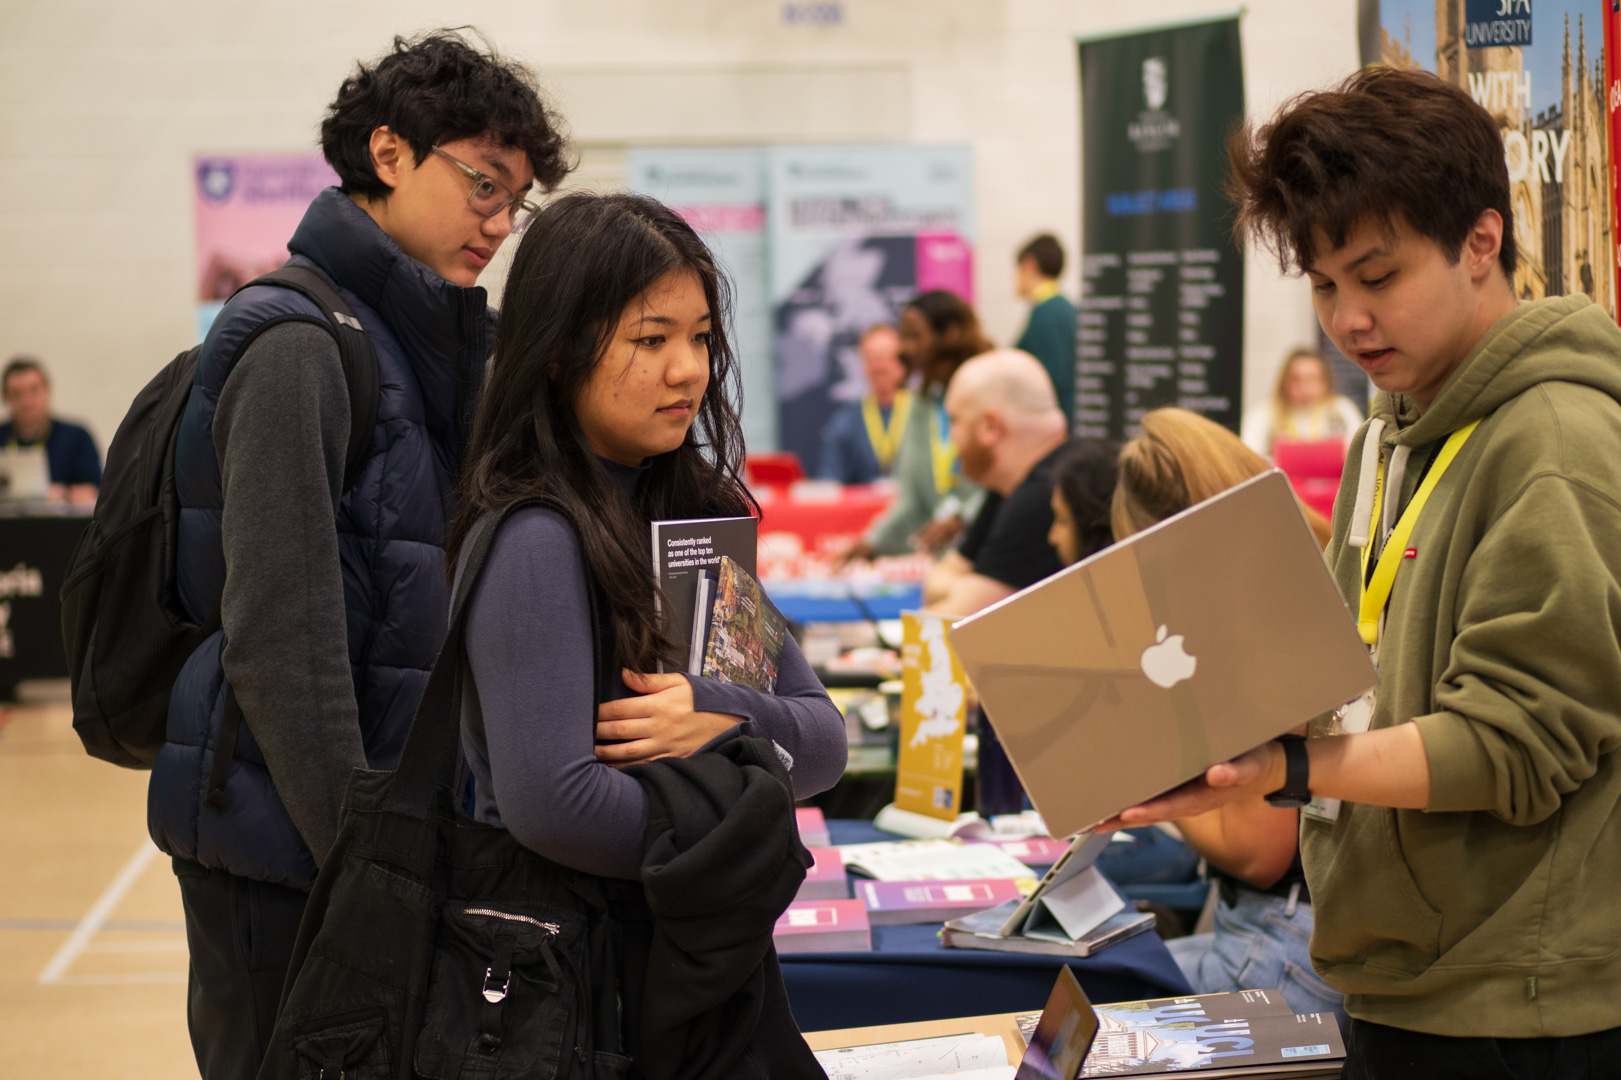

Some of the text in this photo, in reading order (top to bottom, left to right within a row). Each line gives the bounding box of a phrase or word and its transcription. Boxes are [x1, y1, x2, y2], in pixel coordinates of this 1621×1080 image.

[1466, 19, 1531, 45] UNIVERSITY
[1467, 70, 1531, 109] WITH
[1504, 129, 1571, 183] ORY
[667, 536, 711, 547] Consistently ranked
[684, 547, 690, 556] of
[697, 547, 706, 556] top
[668, 559, 694, 568] universities
[695, 557, 699, 566] in
[699, 557, 707, 565] the
[1195, 1022, 1255, 1064] UCL
